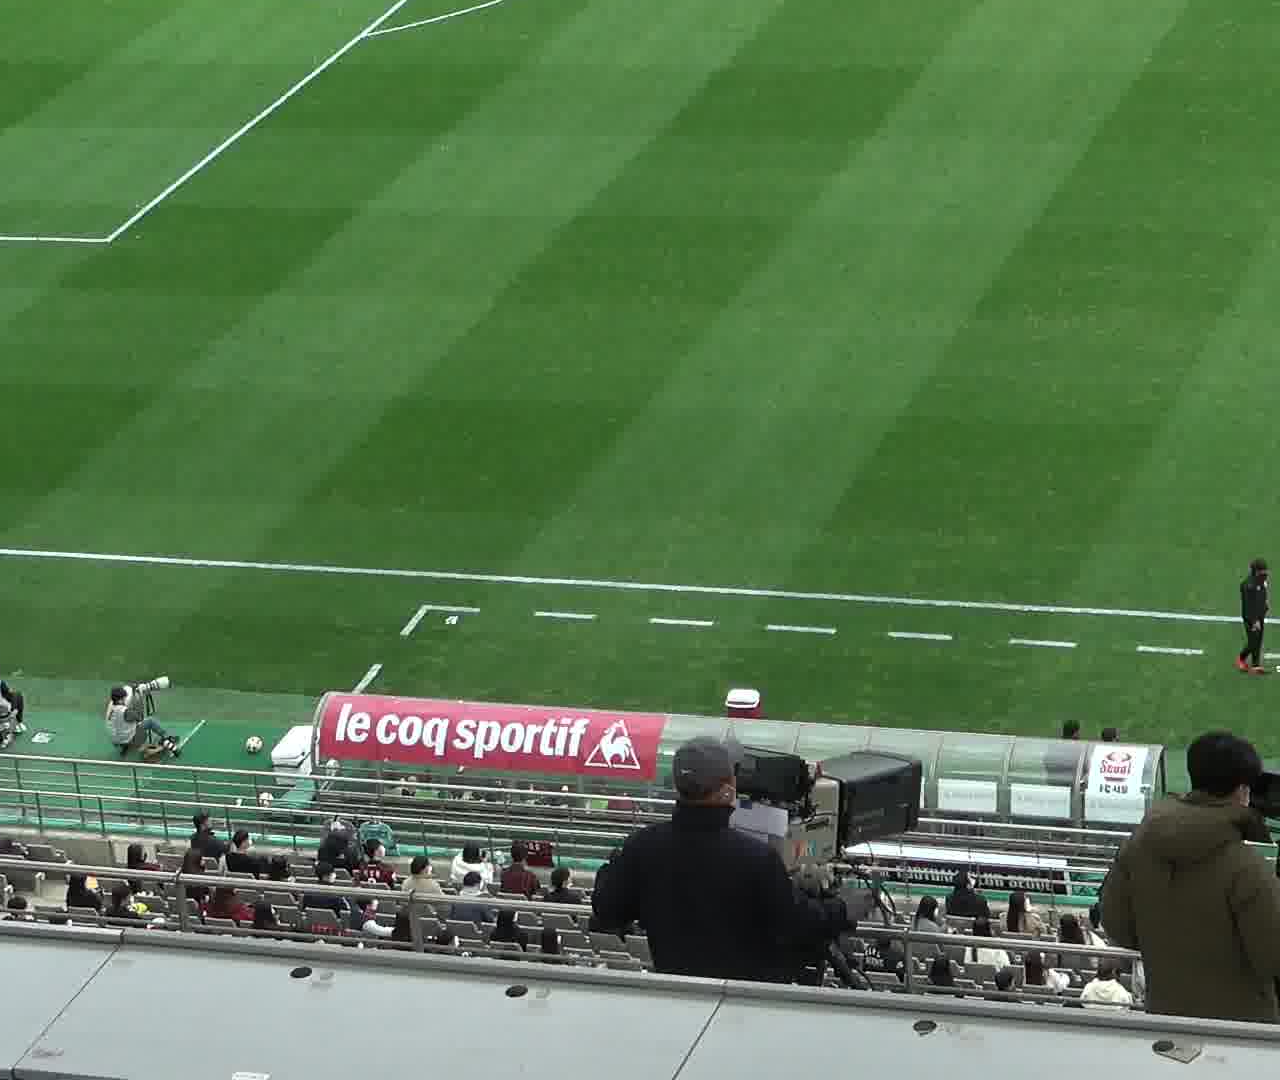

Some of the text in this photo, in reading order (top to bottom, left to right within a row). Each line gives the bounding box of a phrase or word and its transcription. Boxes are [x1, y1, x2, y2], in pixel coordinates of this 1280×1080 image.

[335, 703, 590, 759] le coq sportif
